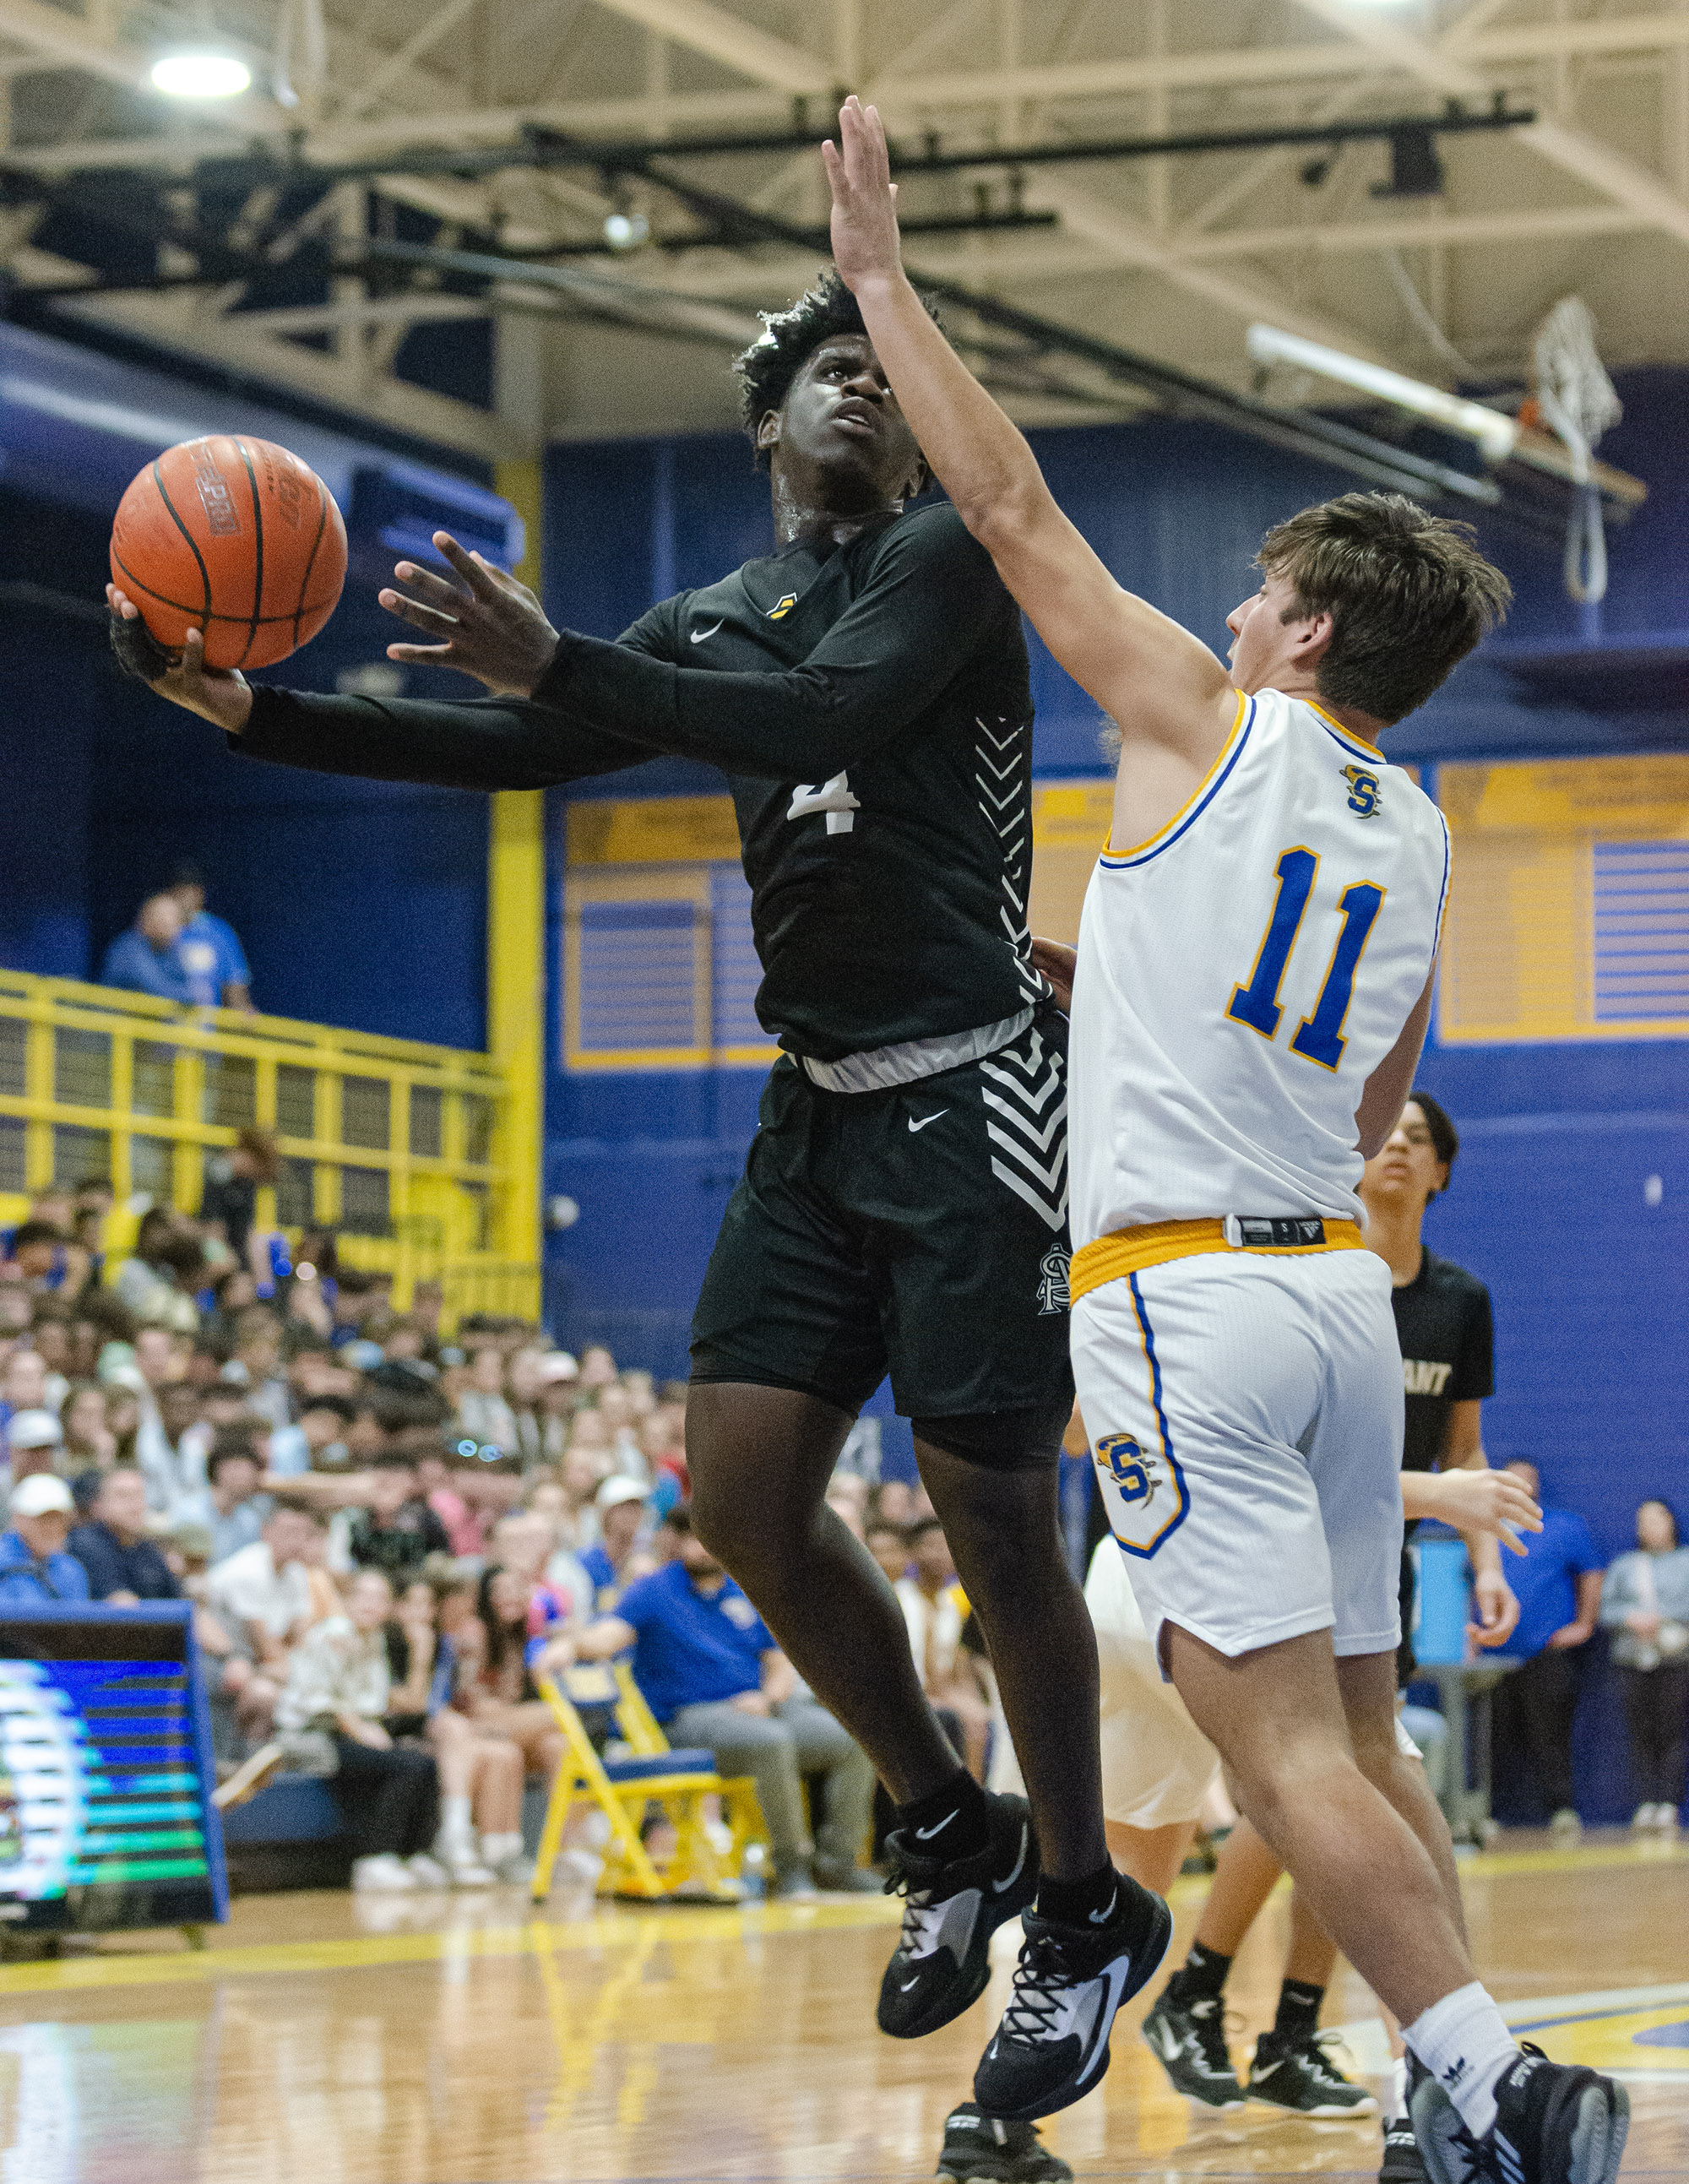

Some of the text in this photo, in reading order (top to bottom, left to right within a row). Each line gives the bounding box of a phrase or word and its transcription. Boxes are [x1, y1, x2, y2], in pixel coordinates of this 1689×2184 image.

[786, 769, 861, 835] 4
[1223, 844, 1388, 1073] 11
[1107, 1438, 1152, 1503] S
